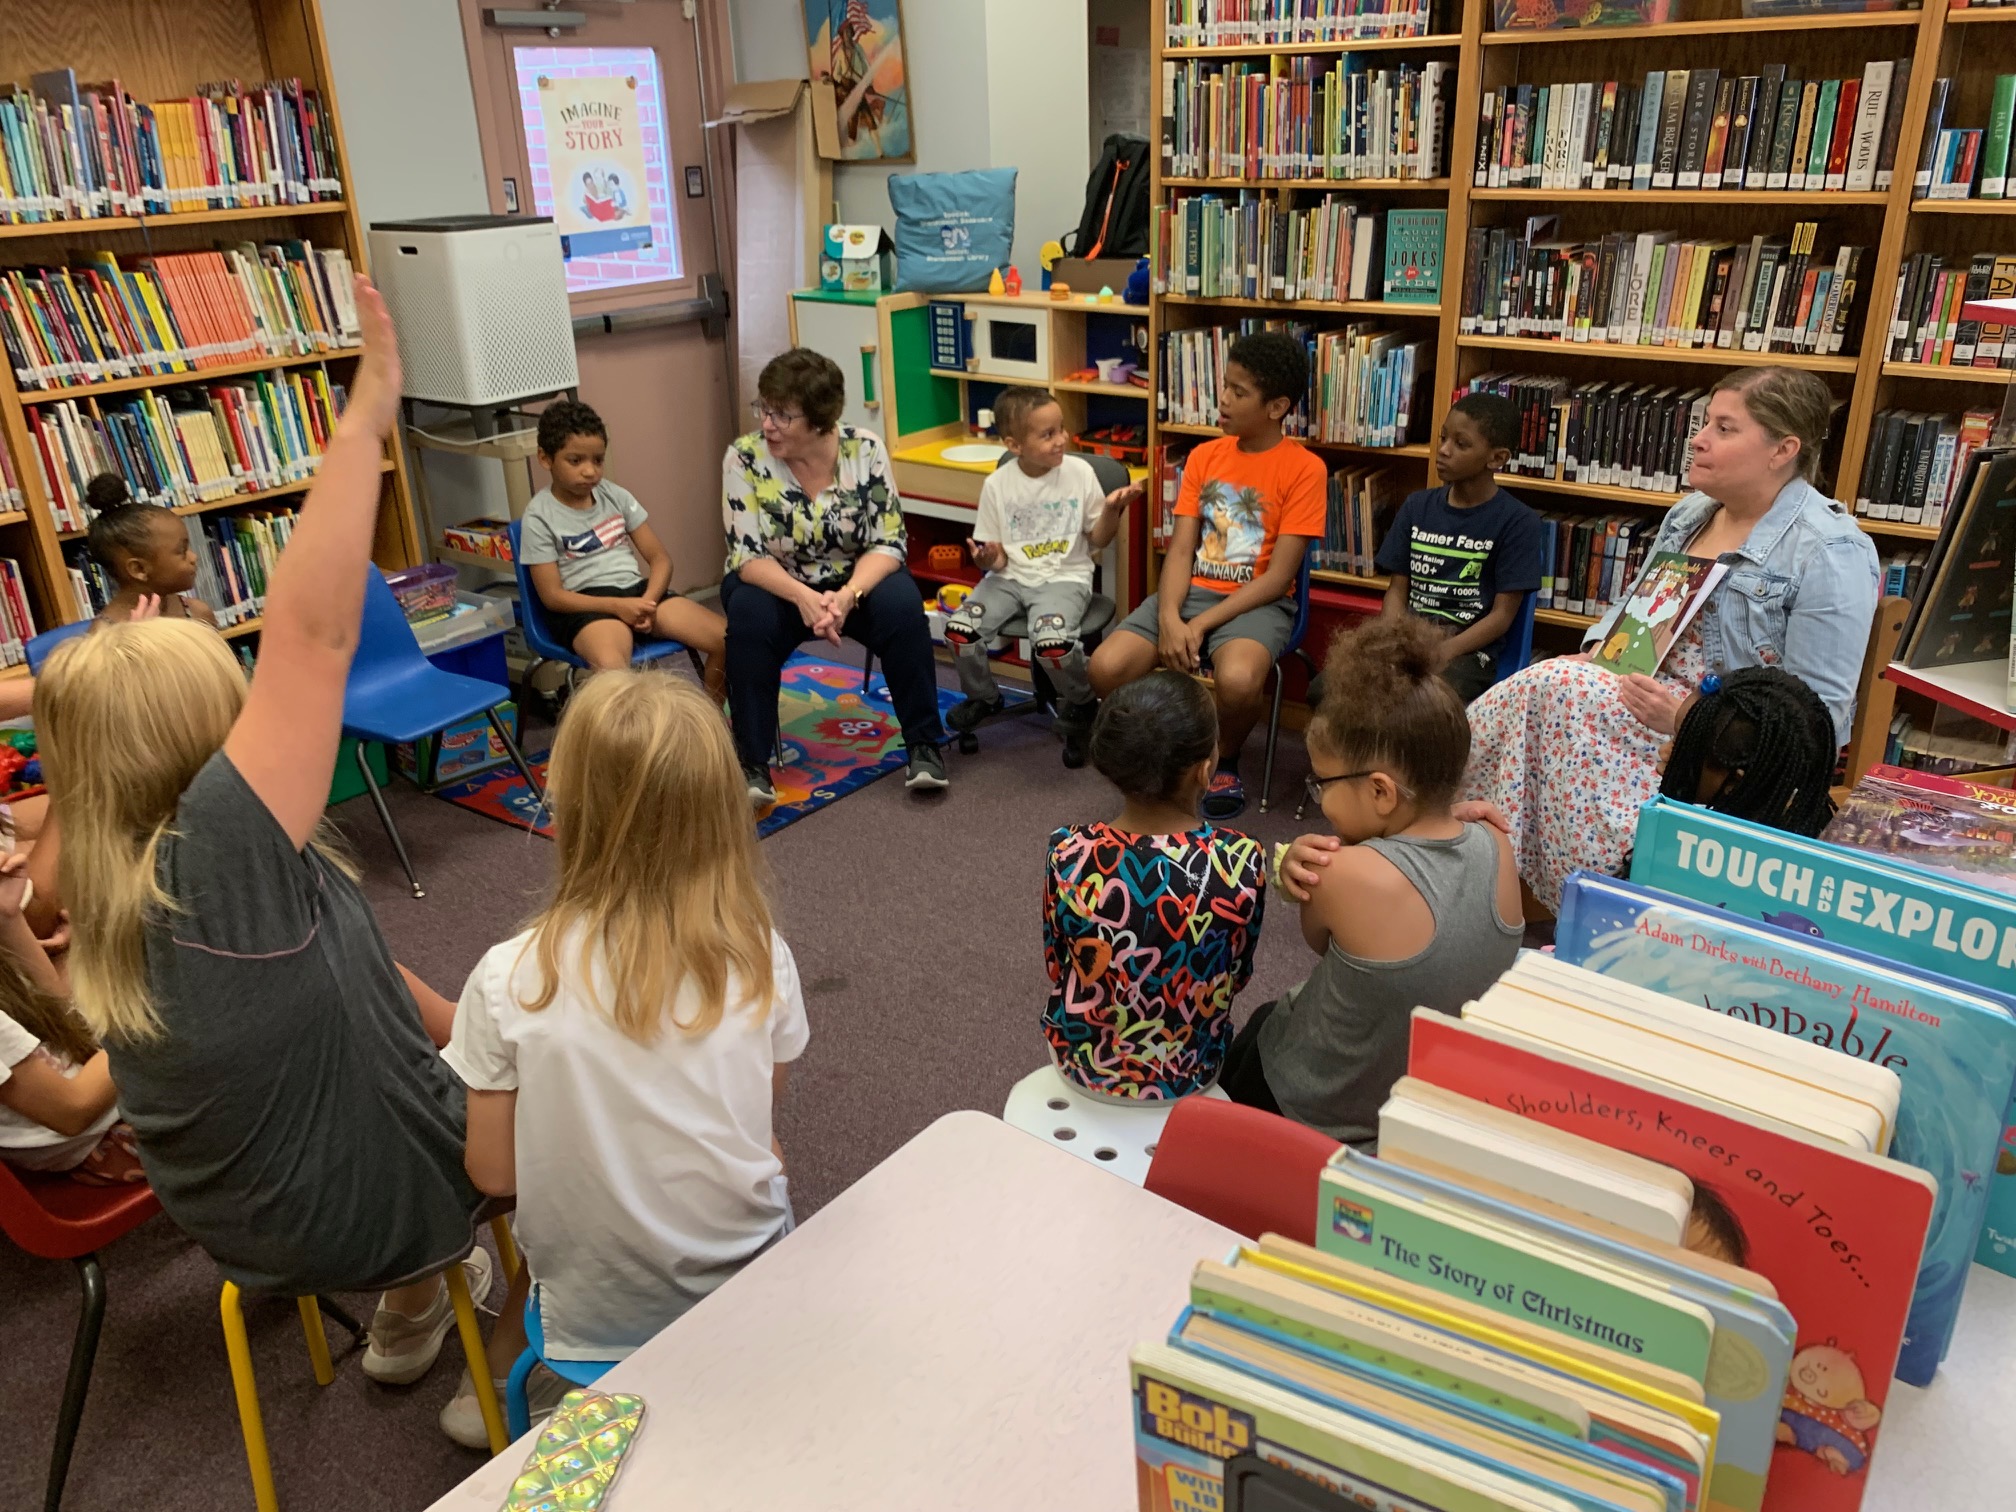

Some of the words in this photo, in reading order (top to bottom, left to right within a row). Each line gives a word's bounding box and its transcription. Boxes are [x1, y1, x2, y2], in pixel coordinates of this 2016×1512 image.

[560, 102, 623, 124] IMAGINE
[1694, 81, 1706, 108] WAR
[1865, 89, 1883, 119] RULE
[565, 128, 624, 151] STORY
[581, 119, 604, 129] YOUR
[1993, 111, 2006, 141] HALF
[1557, 129, 1568, 173] FORG
[1659, 126, 1675, 173] BREAKER
[1685, 127, 1698, 168] STORM
[1856, 130, 1875, 170] WOLVES
[1188, 229, 1198, 267] POETRY
[1391, 251, 1437, 267] JOKES
[1391, 279, 1436, 287] KIDS
[1760, 264, 1771, 281] BLACK
[1627, 263, 1643, 322] LORE
[1692, 415, 1701, 427] WE
[1911, 449, 1931, 497] UNFORGIVEN
[1212, 564, 1253, 584] WAVES
[1676, 829, 1815, 904] TOUCH
[1817, 875, 1836, 913] AND
[1635, 918, 1684, 948] Adam
[1691, 933, 1739, 965] Dirks
[1742, 952, 1767, 972] with
[1769, 958, 1847, 1000] Bethany
[1851, 984, 1942, 1029] Hamilton
[1503, 1090, 1644, 1131] Shoulders,
[1656, 1110, 1739, 1167] Knees
[1745, 1165, 1805, 1208] and
[1806, 1205, 1872, 1289] Toes...
[1380, 1234, 1420, 1268] The
[1428, 1254, 1487, 1297] Story
[1494, 1282, 1516, 1302] of
[1522, 1289, 1645, 1354] Christmas
[1146, 1381, 1249, 1448] Bob
